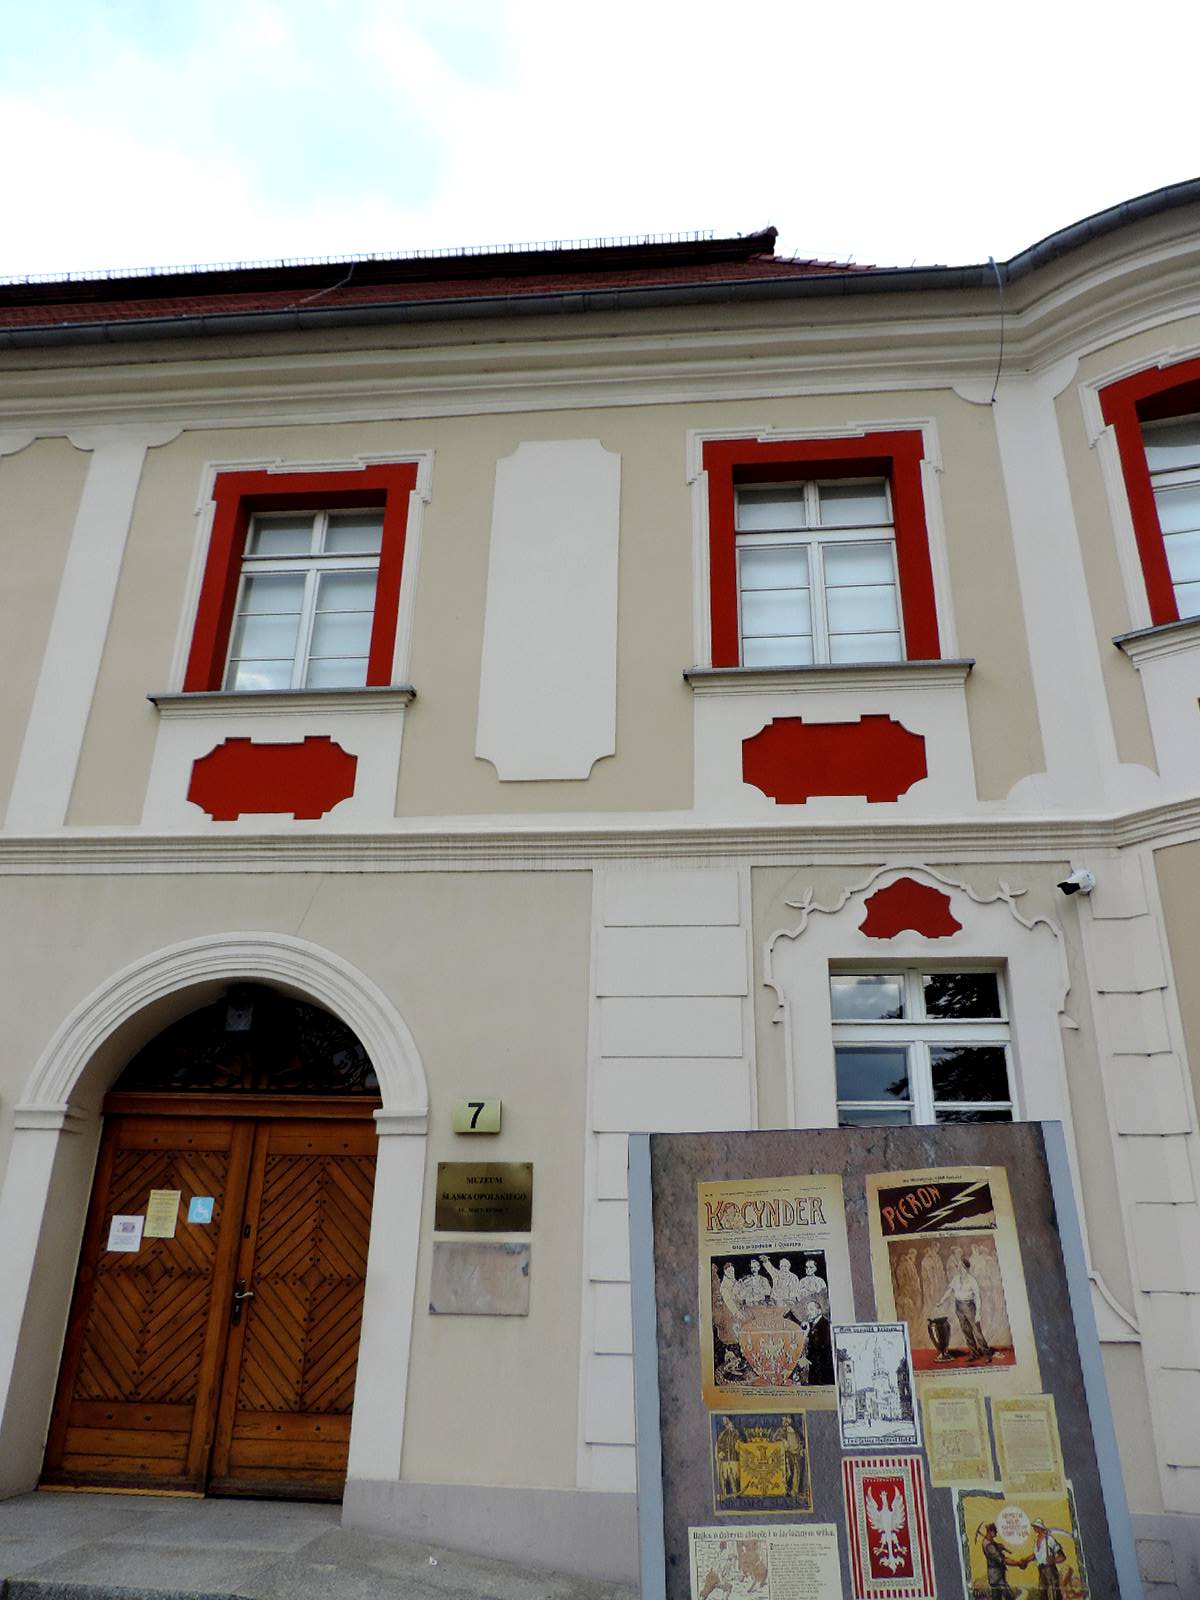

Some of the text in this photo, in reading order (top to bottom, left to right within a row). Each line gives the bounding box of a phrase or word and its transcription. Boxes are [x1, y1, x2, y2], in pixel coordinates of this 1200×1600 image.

[467, 1102, 485, 1129] 7
[466, 1176, 503, 1185] MUZEUM
[473, 1192, 527, 1201] OPOLSKIEGO
[703, 1196, 827, 1231] KOCYNDER
